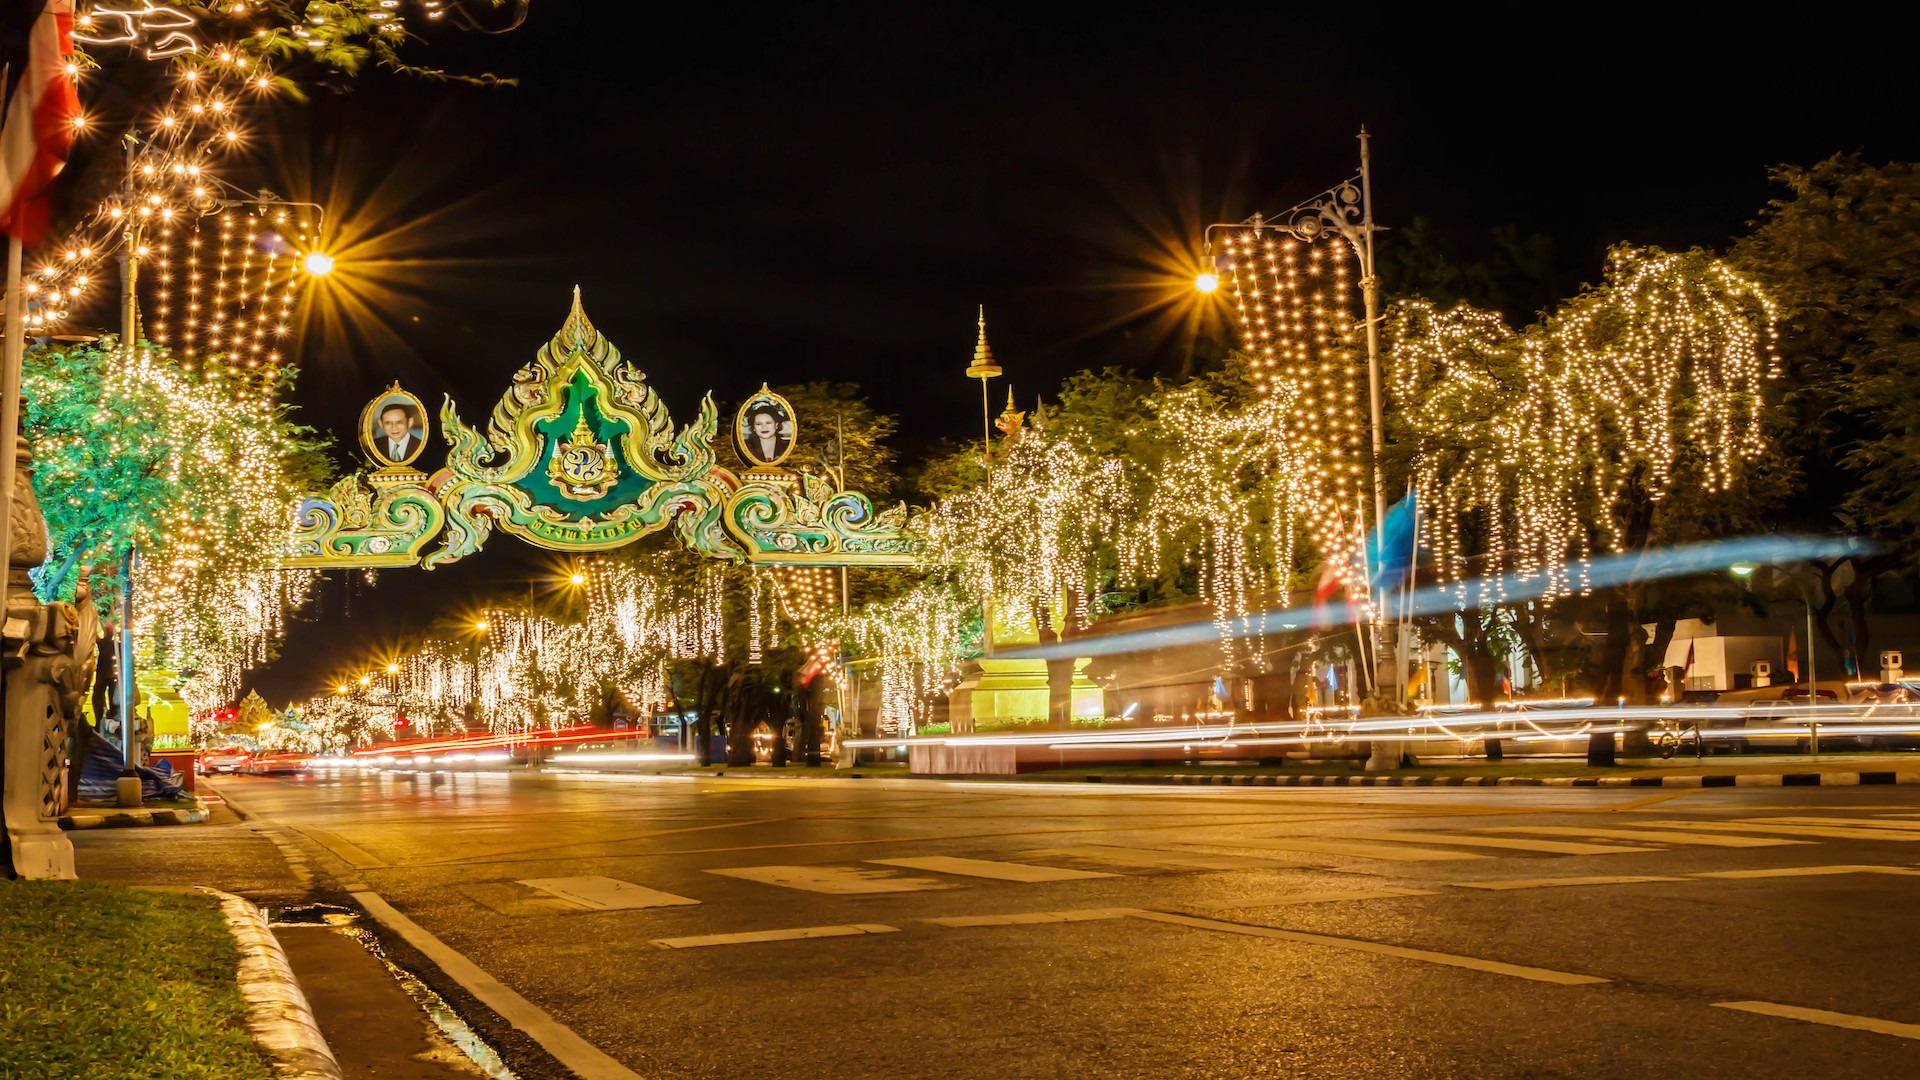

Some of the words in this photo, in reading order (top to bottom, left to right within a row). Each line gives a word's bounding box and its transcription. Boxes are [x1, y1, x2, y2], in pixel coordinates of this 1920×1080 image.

[531, 518, 642, 541] ทรงพระเจริญ
